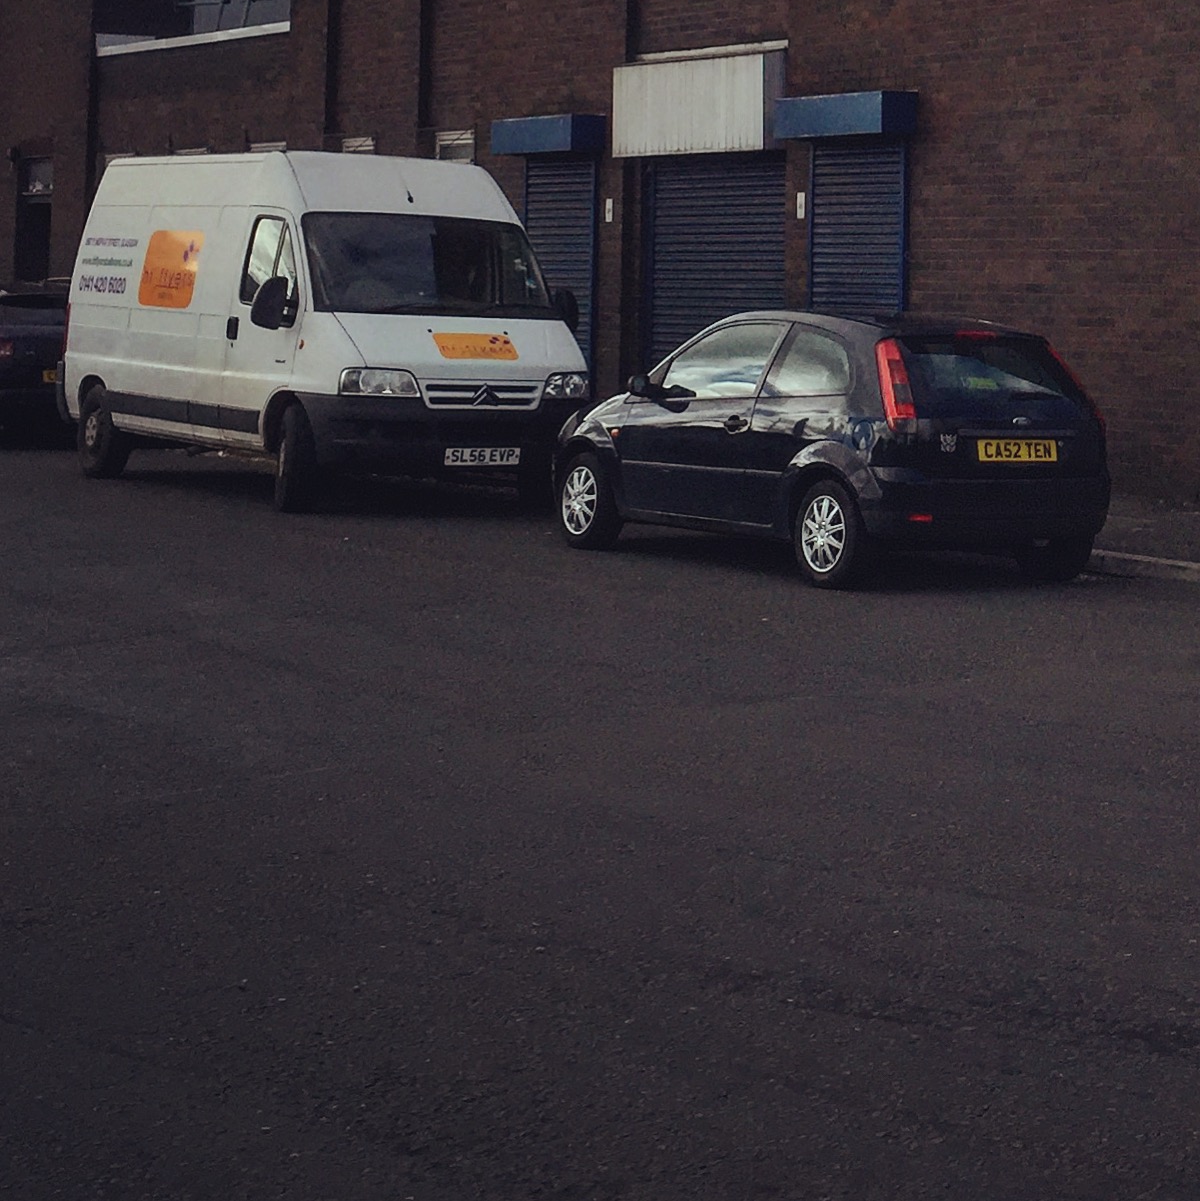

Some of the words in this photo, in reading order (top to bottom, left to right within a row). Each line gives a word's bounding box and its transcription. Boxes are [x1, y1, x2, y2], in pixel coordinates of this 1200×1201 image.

[78, 274, 94, 292] 0141
[94, 276, 108, 293] 420
[108, 276, 127, 294] 6020
[451, 449, 486, 463] SL56
[489, 449, 515, 462] EVP
[984, 441, 1021, 458] CA52
[1025, 441, 1052, 458] TEN
